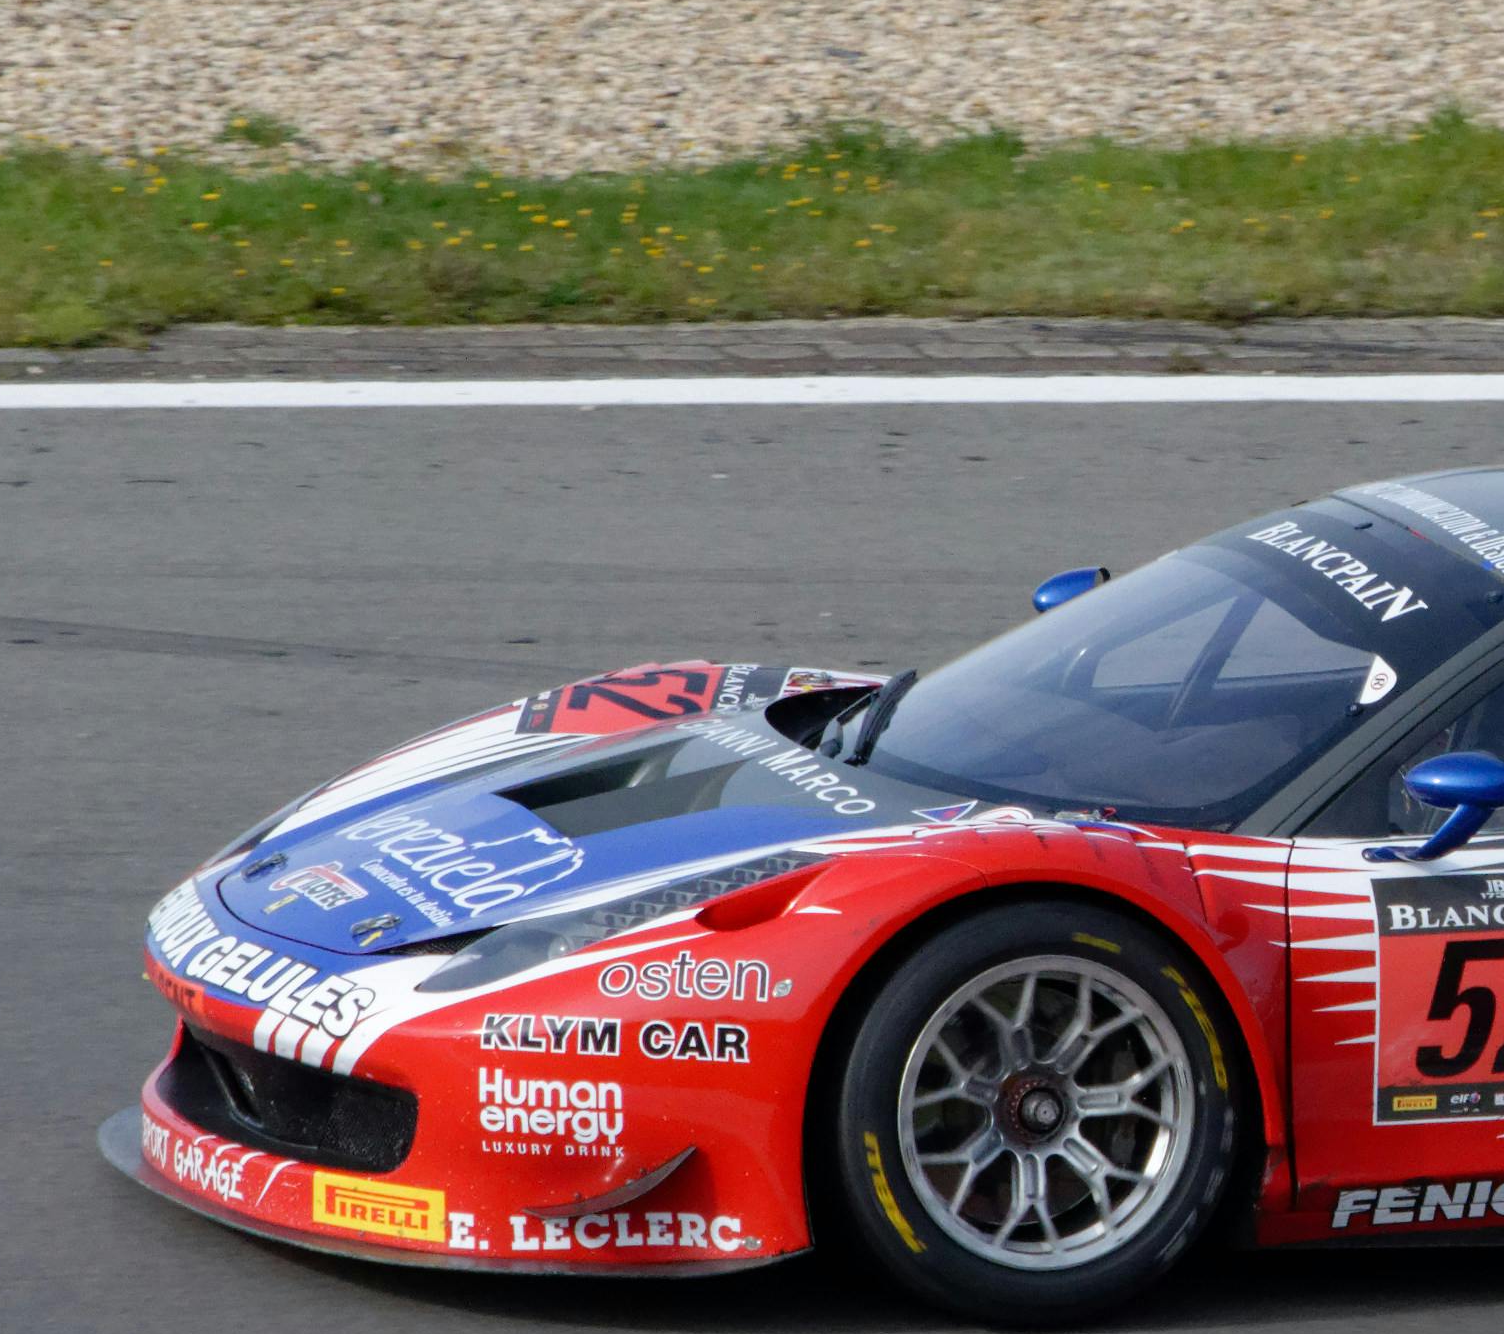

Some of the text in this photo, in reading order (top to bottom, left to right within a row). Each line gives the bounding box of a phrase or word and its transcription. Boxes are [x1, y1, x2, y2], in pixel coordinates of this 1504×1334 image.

[1246, 521, 1429, 623] BLANCPAIN
[758, 748, 876, 815] MARCO
[186, 936, 377, 1039] GELULES
[480, 1013, 751, 1064] KLYM CAR
[478, 1067, 624, 1109] Human
[479, 1106, 625, 1145] energy
[482, 1139, 626, 1158] LUXURY DRINK
[173, 1138, 245, 1201] GARAGE
[324, 1183, 431, 1231] PIRELLI
[448, 1212, 743, 1252] E. LECLERC
